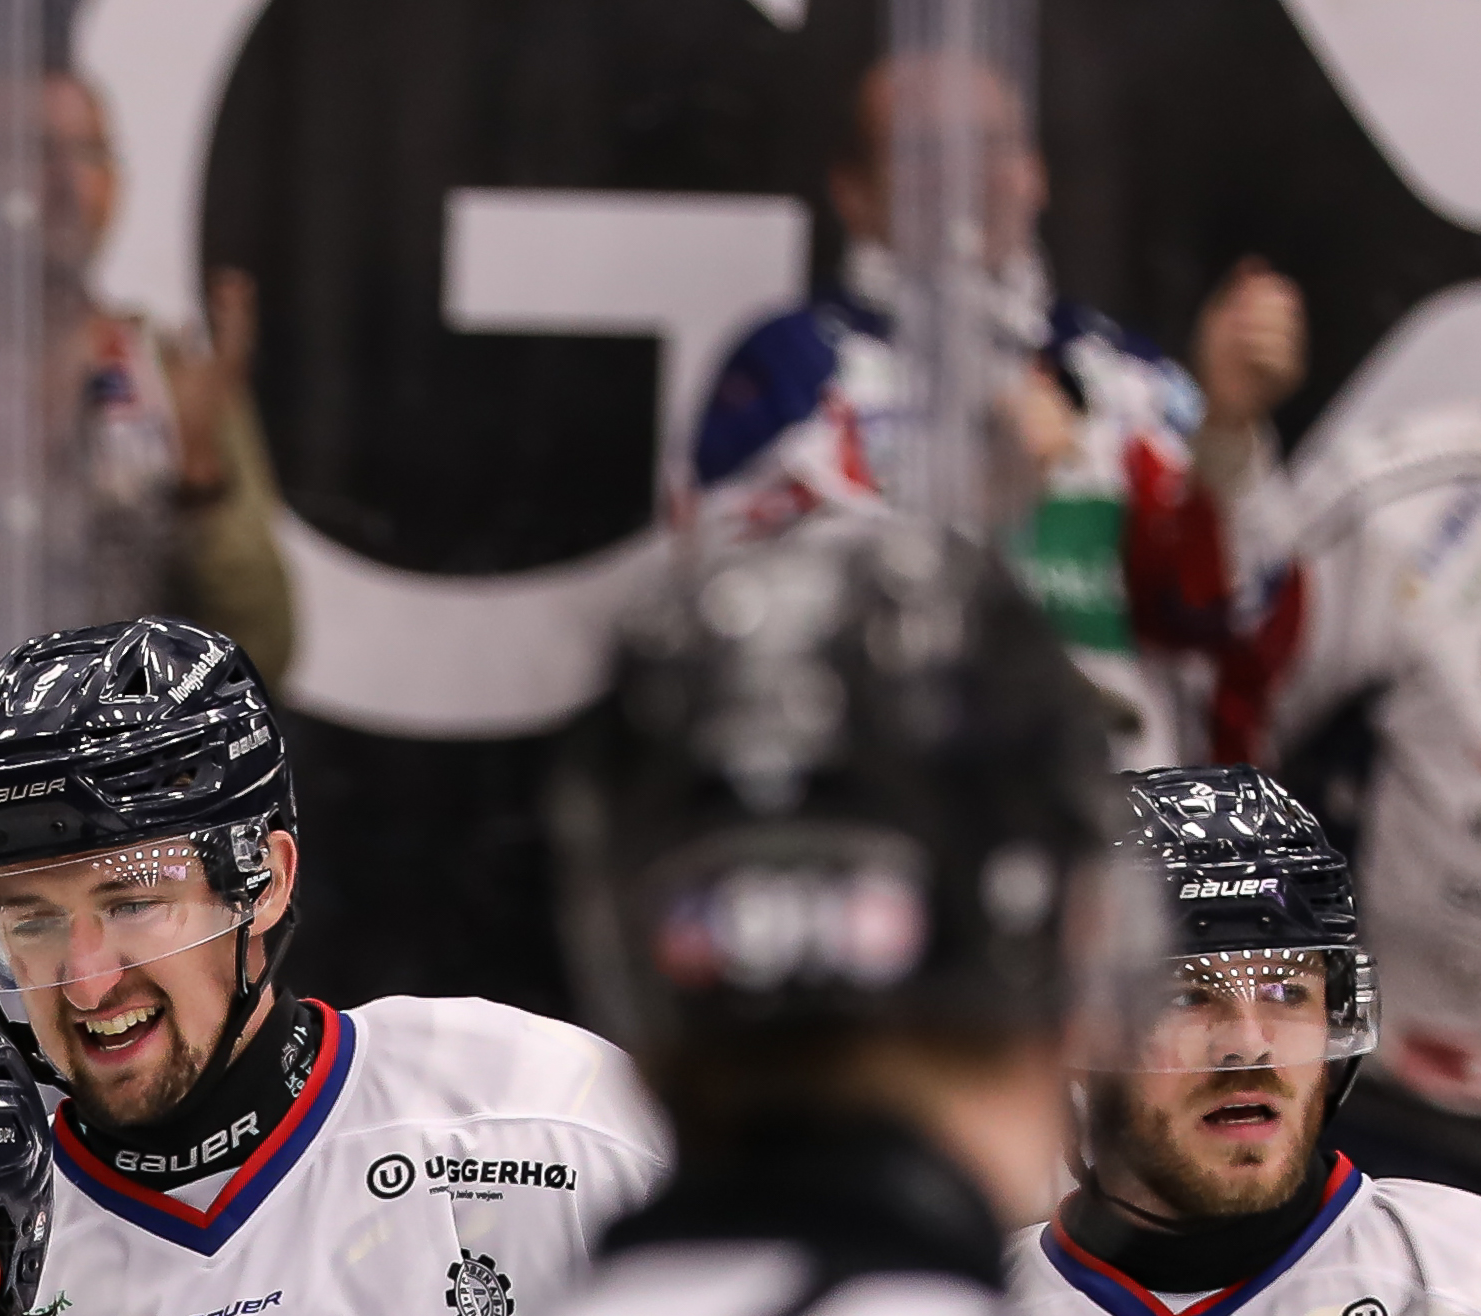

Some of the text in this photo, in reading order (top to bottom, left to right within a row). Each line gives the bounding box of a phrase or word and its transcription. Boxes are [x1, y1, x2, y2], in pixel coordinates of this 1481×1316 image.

[1179, 878, 1280, 900] BAUER
[115, 1110, 259, 1173] BAUER
[425, 1156, 577, 1191] UGGERHØJ
